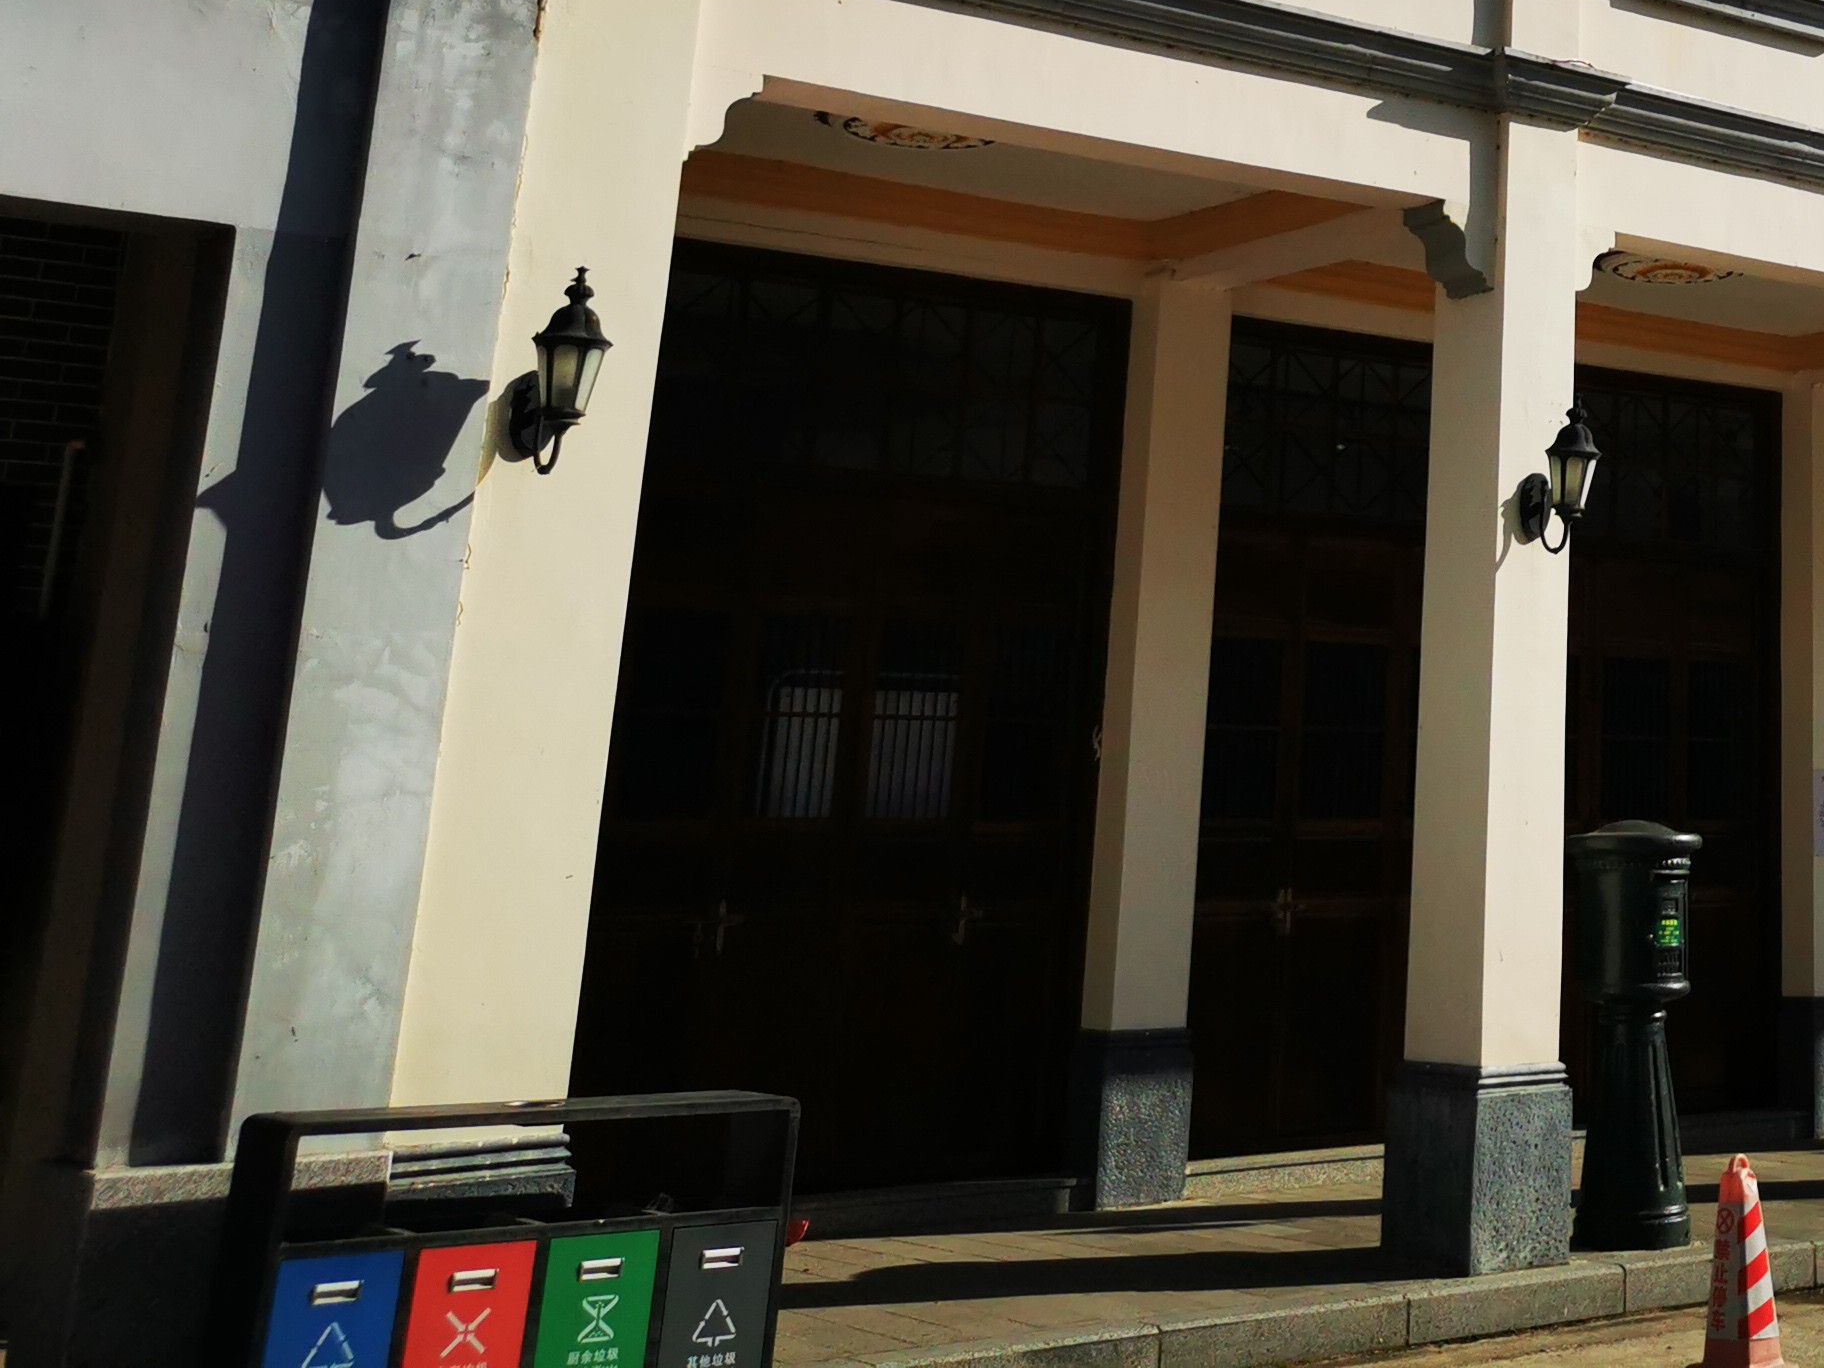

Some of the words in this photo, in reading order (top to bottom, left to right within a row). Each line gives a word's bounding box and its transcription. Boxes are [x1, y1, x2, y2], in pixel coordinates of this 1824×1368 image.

[566, 1347, 619, 1366] 厨余垃圾
[686, 1352, 737, 1368] 其他垃圾
